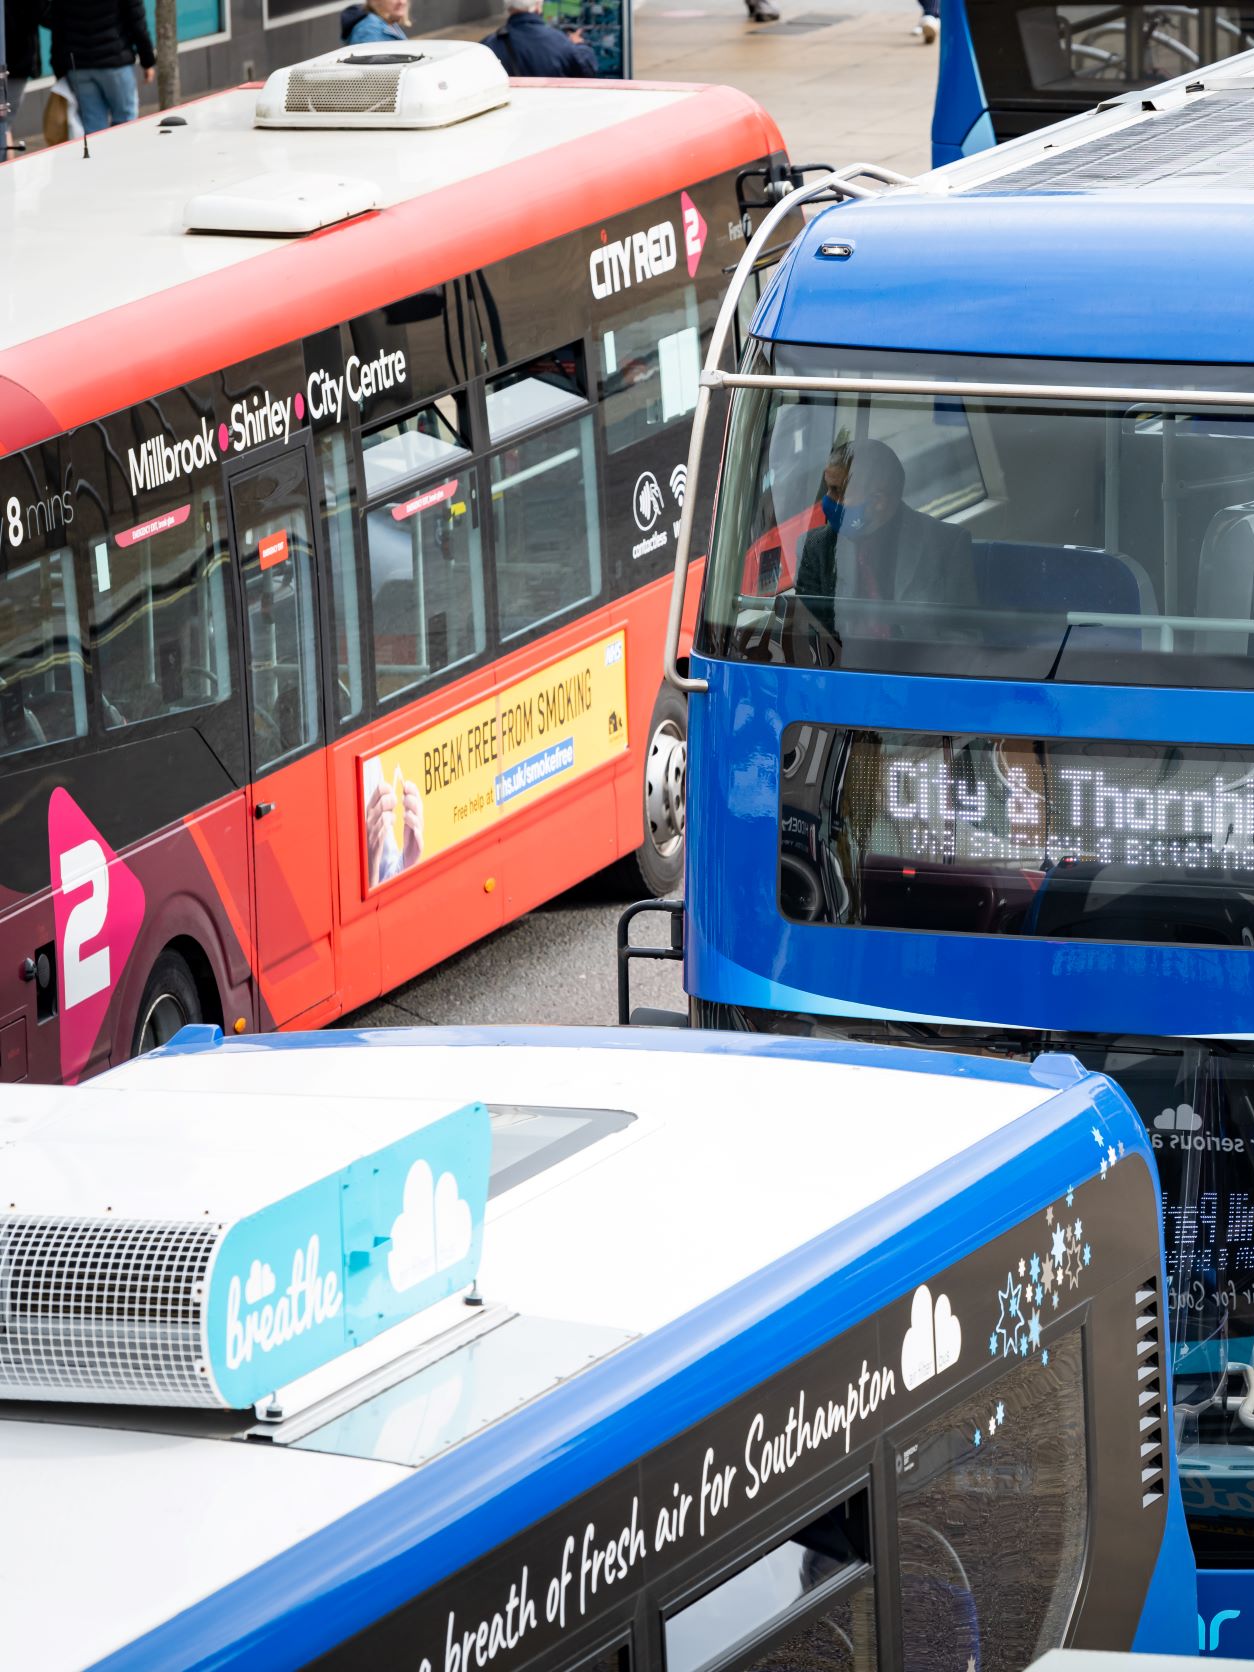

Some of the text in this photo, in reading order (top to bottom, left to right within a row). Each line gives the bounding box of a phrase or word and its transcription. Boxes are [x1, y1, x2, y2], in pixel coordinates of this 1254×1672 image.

[590, 220, 677, 300] CITY RED
[684, 208, 702, 256] 2
[128, 349, 407, 496] Millbrook Shirley City Centre
[6, 485, 74, 547] 8 mins
[424, 668, 592, 795] BREAK FREE FROM SMOKING
[453, 746, 573, 824] Free help at nhs.uk/smokefree
[889, 762, 985, 821] City
[1007, 768, 1040, 823] &
[61, 839, 110, 1010] 2
[226, 1233, 343, 1370] breathe
[445, 1360, 896, 1672] breath of fresh air for Southampton
